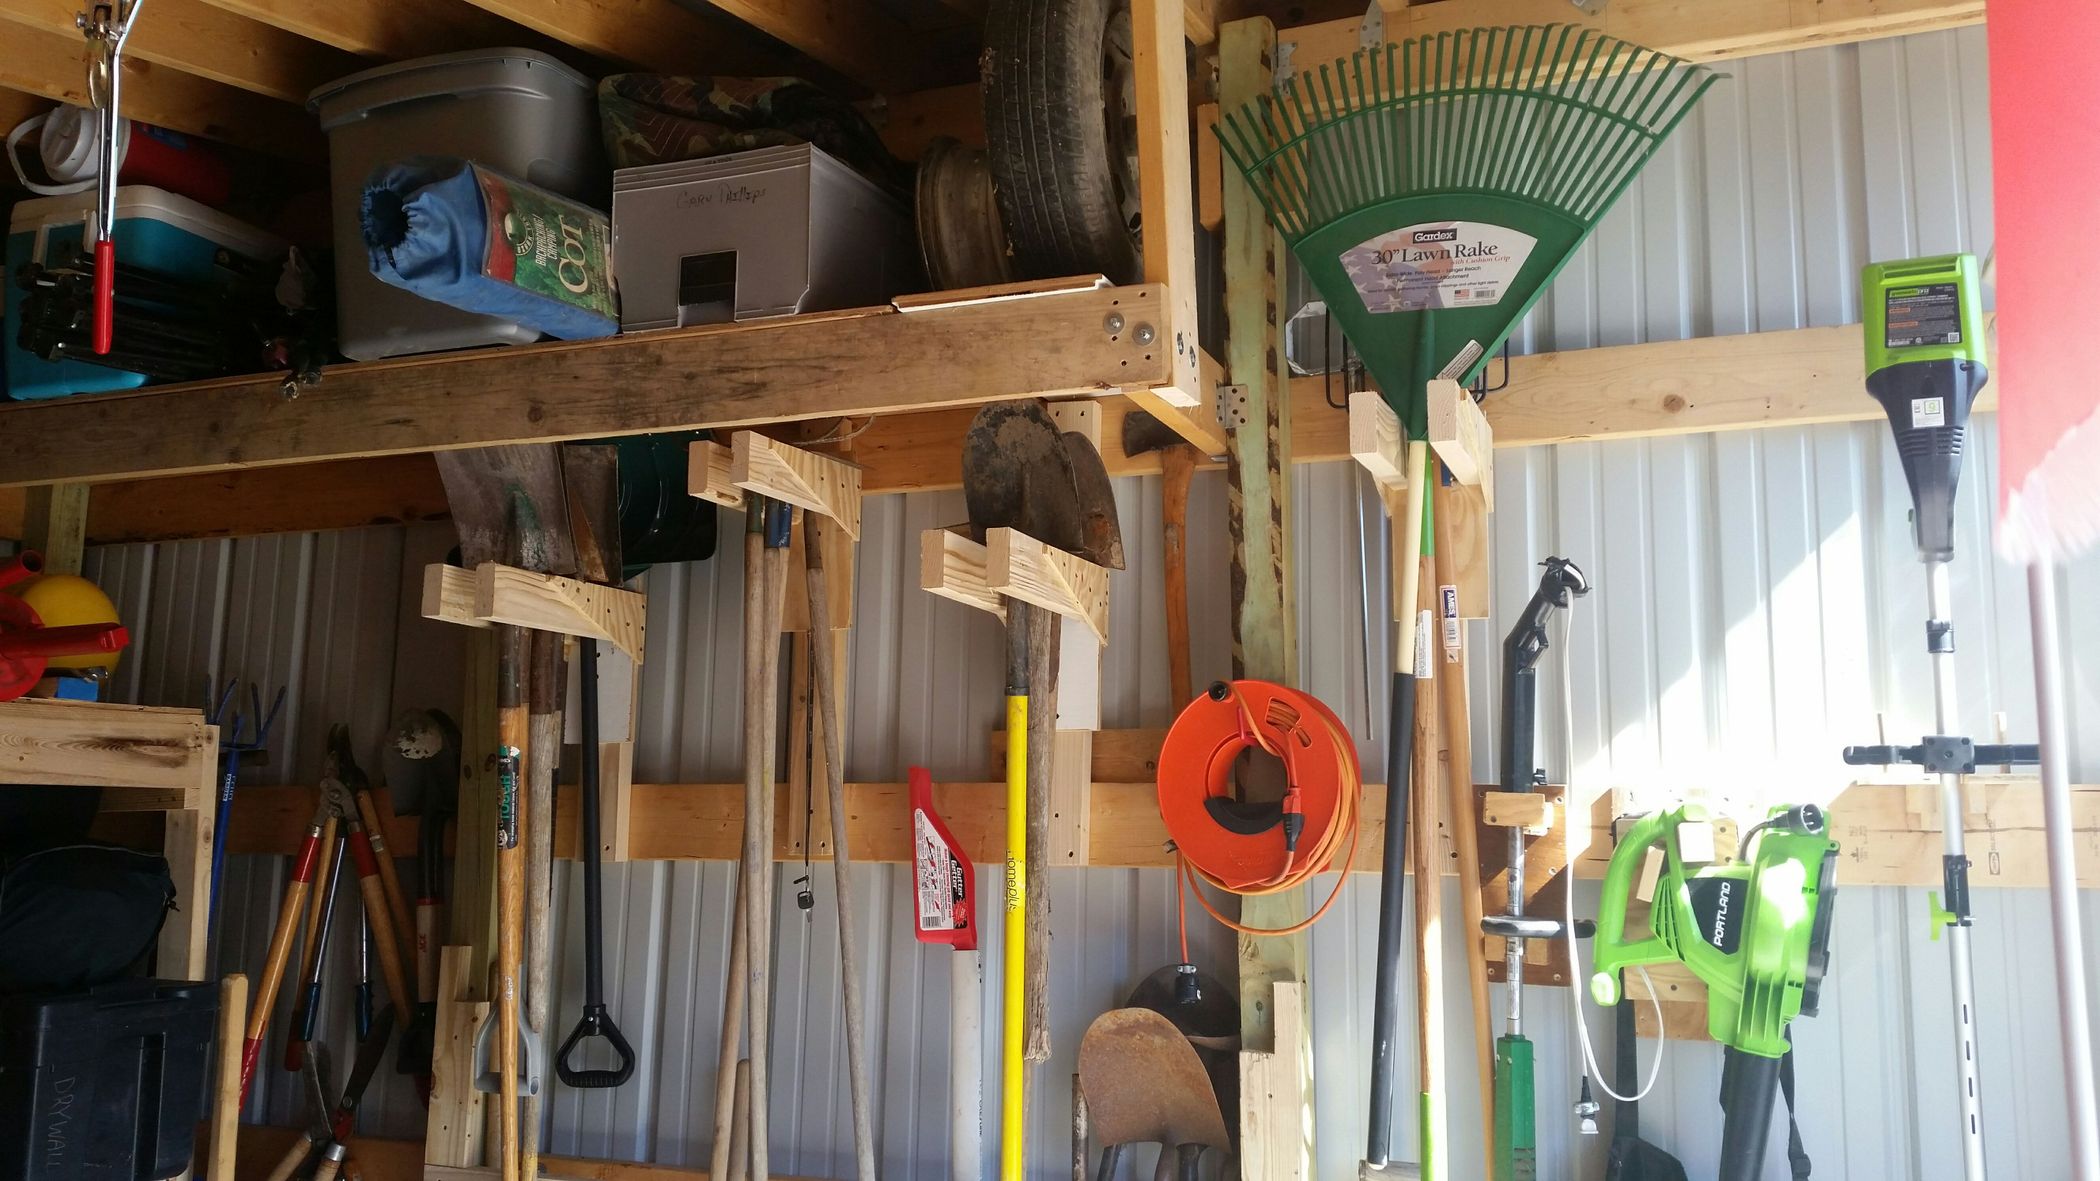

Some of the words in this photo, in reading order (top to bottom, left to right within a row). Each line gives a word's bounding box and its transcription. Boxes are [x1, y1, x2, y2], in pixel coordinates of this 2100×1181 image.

[1414, 231, 1454, 242] Gardex
[558, 214, 589, 293] COT
[1402, 247, 1451, 263] Lawn
[1454, 241, 1499, 259] Rake
[1494, 255, 1511, 263] Grip
[1447, 591, 1455, 617] AMES
[1713, 881, 1731, 947] PORTLAND
